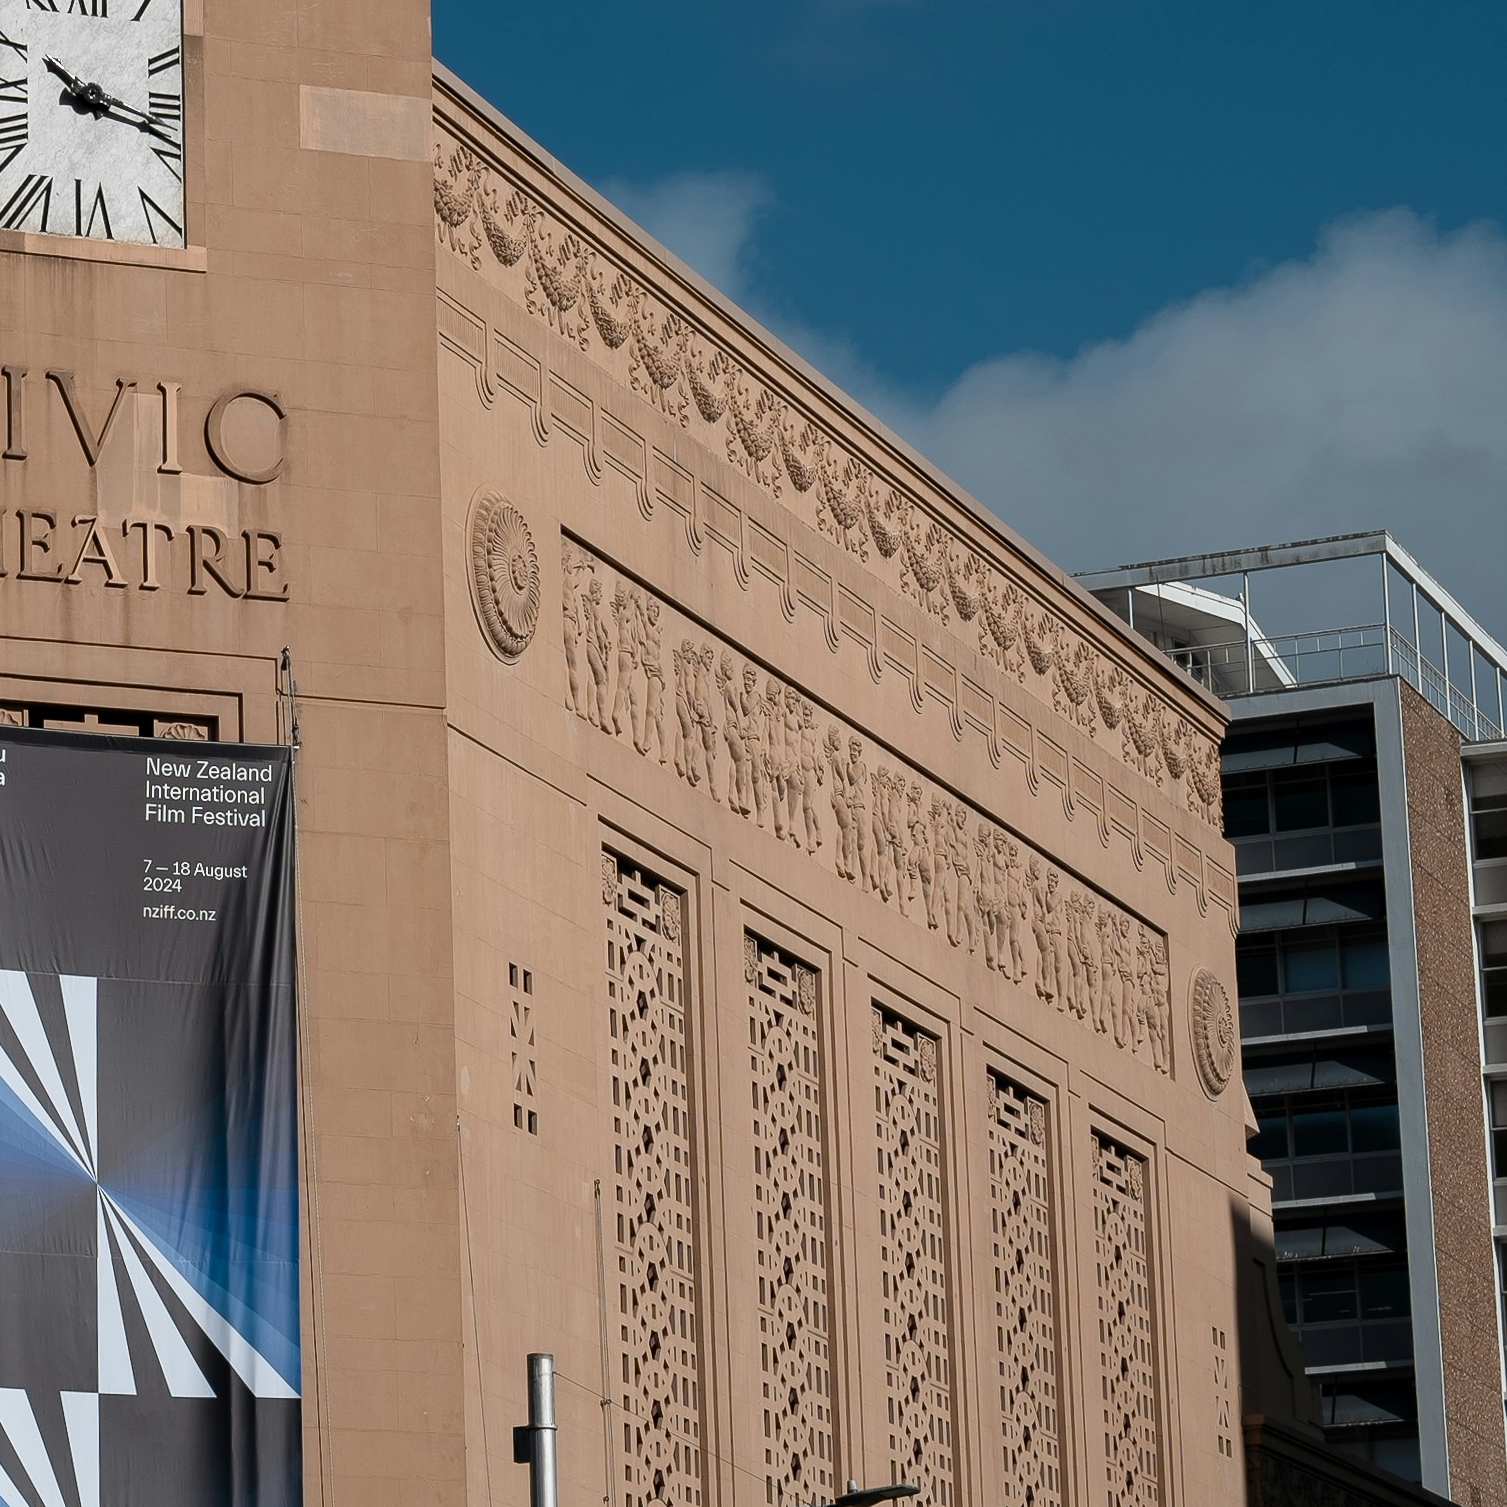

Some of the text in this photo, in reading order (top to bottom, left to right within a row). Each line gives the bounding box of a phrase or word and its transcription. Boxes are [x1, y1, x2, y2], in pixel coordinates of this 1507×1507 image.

[145, 757, 272, 782] New Zealand
[145, 780, 265, 804] International
[145, 803, 265, 827] Film Festival
[143, 858, 153, 874] 7
[172, 861, 191, 876] 18
[193, 862, 248, 881] August
[143, 876, 183, 893] 2024
[142, 904, 217, 922] nziff.co.nz
